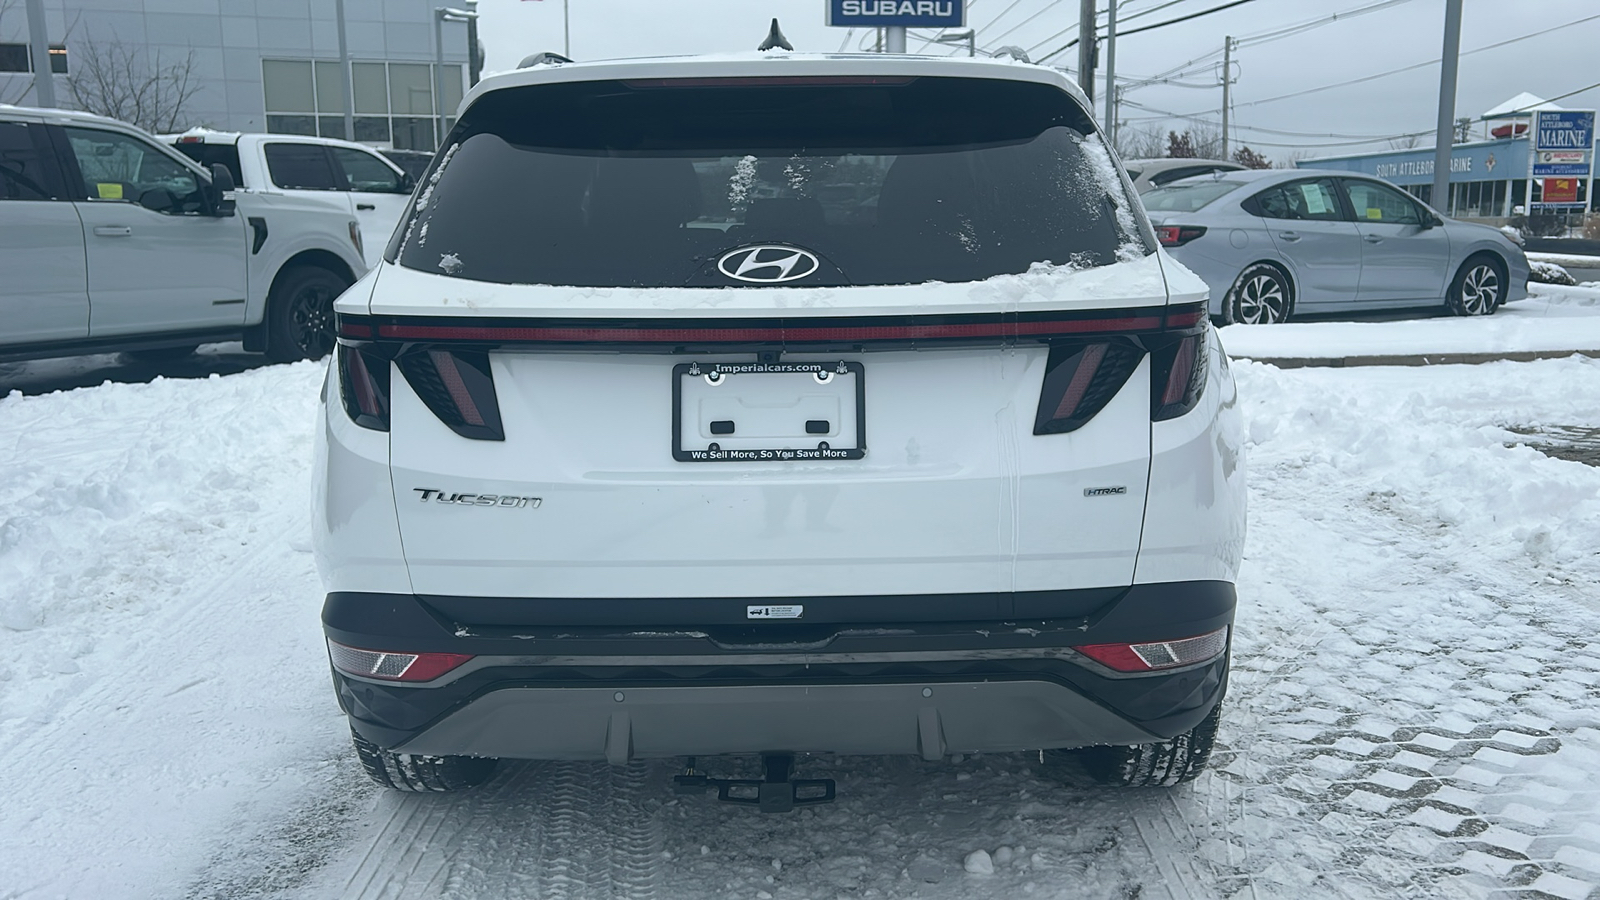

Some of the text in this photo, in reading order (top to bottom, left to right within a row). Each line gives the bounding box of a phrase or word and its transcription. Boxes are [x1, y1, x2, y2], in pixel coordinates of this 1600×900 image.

[842, 0, 953, 16] SUBARU
[1541, 113, 1560, 121] SOUTH
[1541, 121, 1574, 129] ATTLEBORO
[1540, 129, 1586, 147] MARINE
[1376, 157, 1472, 178] SOUTH ATTLEBOR ARINE
[715, 364, 821, 374] Imperialcars.com
[692, 449, 847, 460] We Sell More, So You Save More
[1088, 487, 1124, 496] HTRAC
